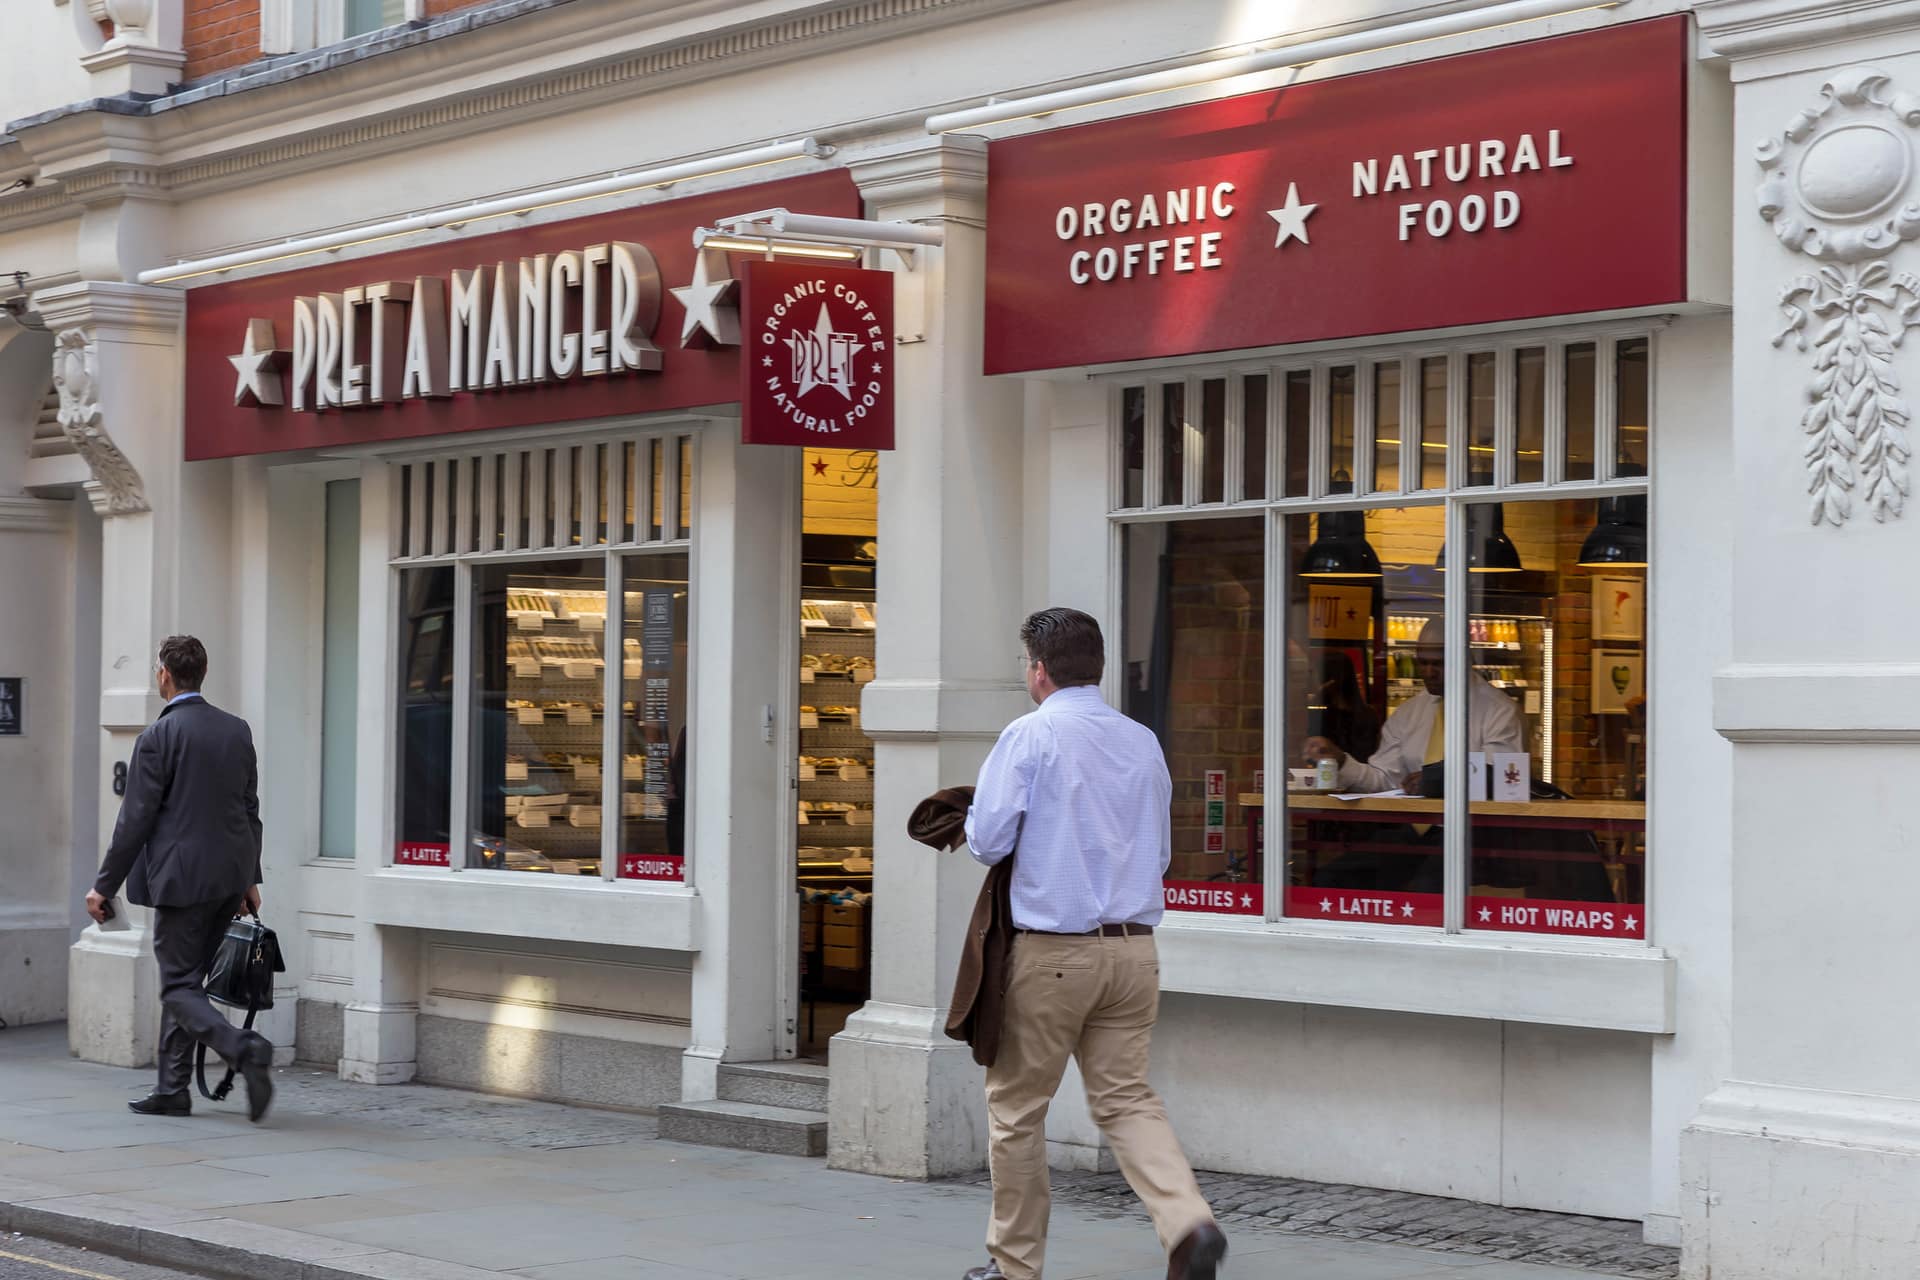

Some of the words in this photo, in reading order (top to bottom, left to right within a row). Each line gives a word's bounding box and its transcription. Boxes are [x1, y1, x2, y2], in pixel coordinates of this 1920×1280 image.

[1352, 130, 1573, 197] NATURAL
[1056, 182, 1235, 240] ORGANIC
[1399, 190, 1521, 241] FOOD
[1070, 232, 1222, 284] COFFEE
[292, 281, 410, 412] PRET
[402, 275, 444, 399] A
[449, 241, 662, 393] MANGER
[762, 280, 826, 345] ORGANIC
[834, 284, 885, 352] COFFEE
[792, 328, 858, 386] PRET
[766, 376, 841, 433] NATURAL
[845, 381, 881, 426] FOOD
[412, 847, 441, 862] LATTE
[636, 860, 674, 876] SOUPS
[1339, 897, 1394, 917] LATTE
[1501, 906, 1539, 926] HOT
[1545, 908, 1615, 930] WRAPS
